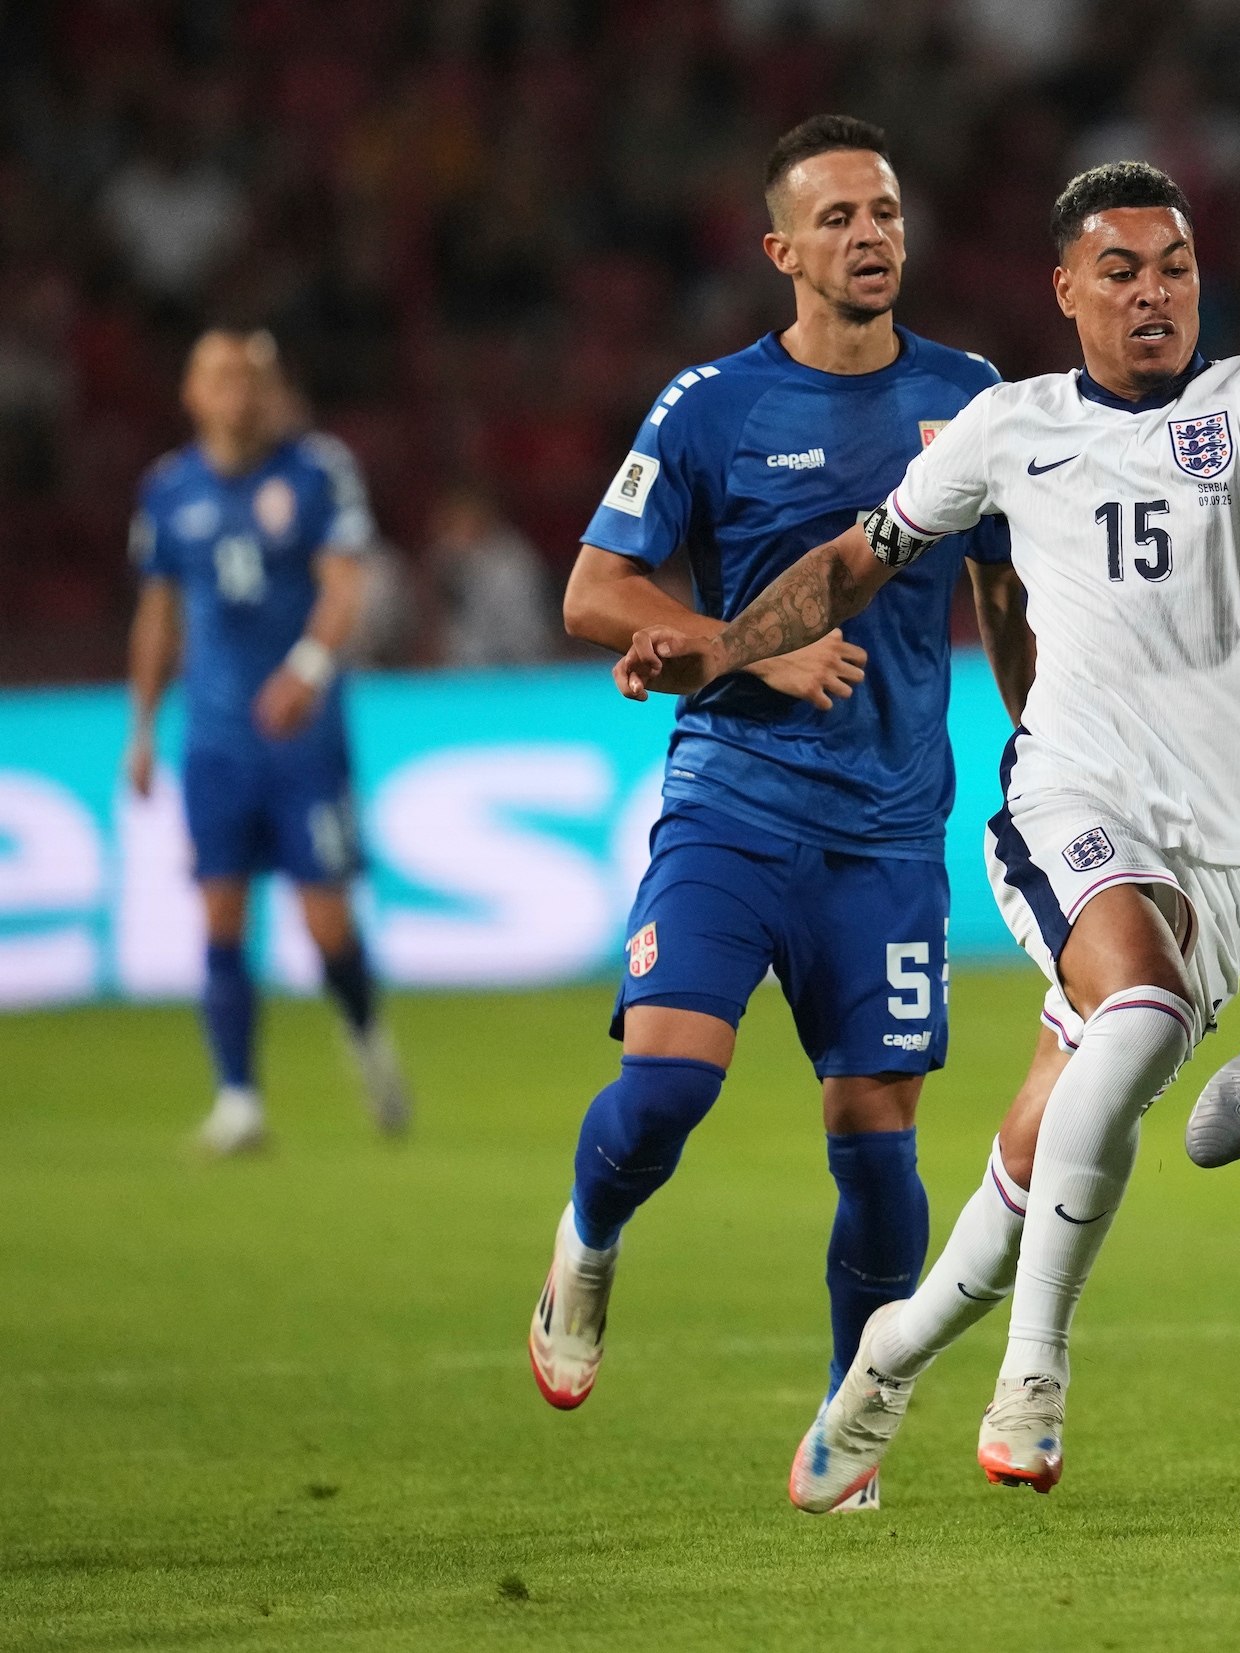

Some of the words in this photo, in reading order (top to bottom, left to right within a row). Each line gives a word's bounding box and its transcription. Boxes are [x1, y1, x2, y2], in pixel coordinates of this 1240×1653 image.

[767, 448, 825, 469] capelli
[1198, 482, 1229, 493] SERBIA
[1199, 495, 1232, 507] 09.09.25
[1094, 499, 1174, 582] 15
[886, 942, 930, 1020] 5
